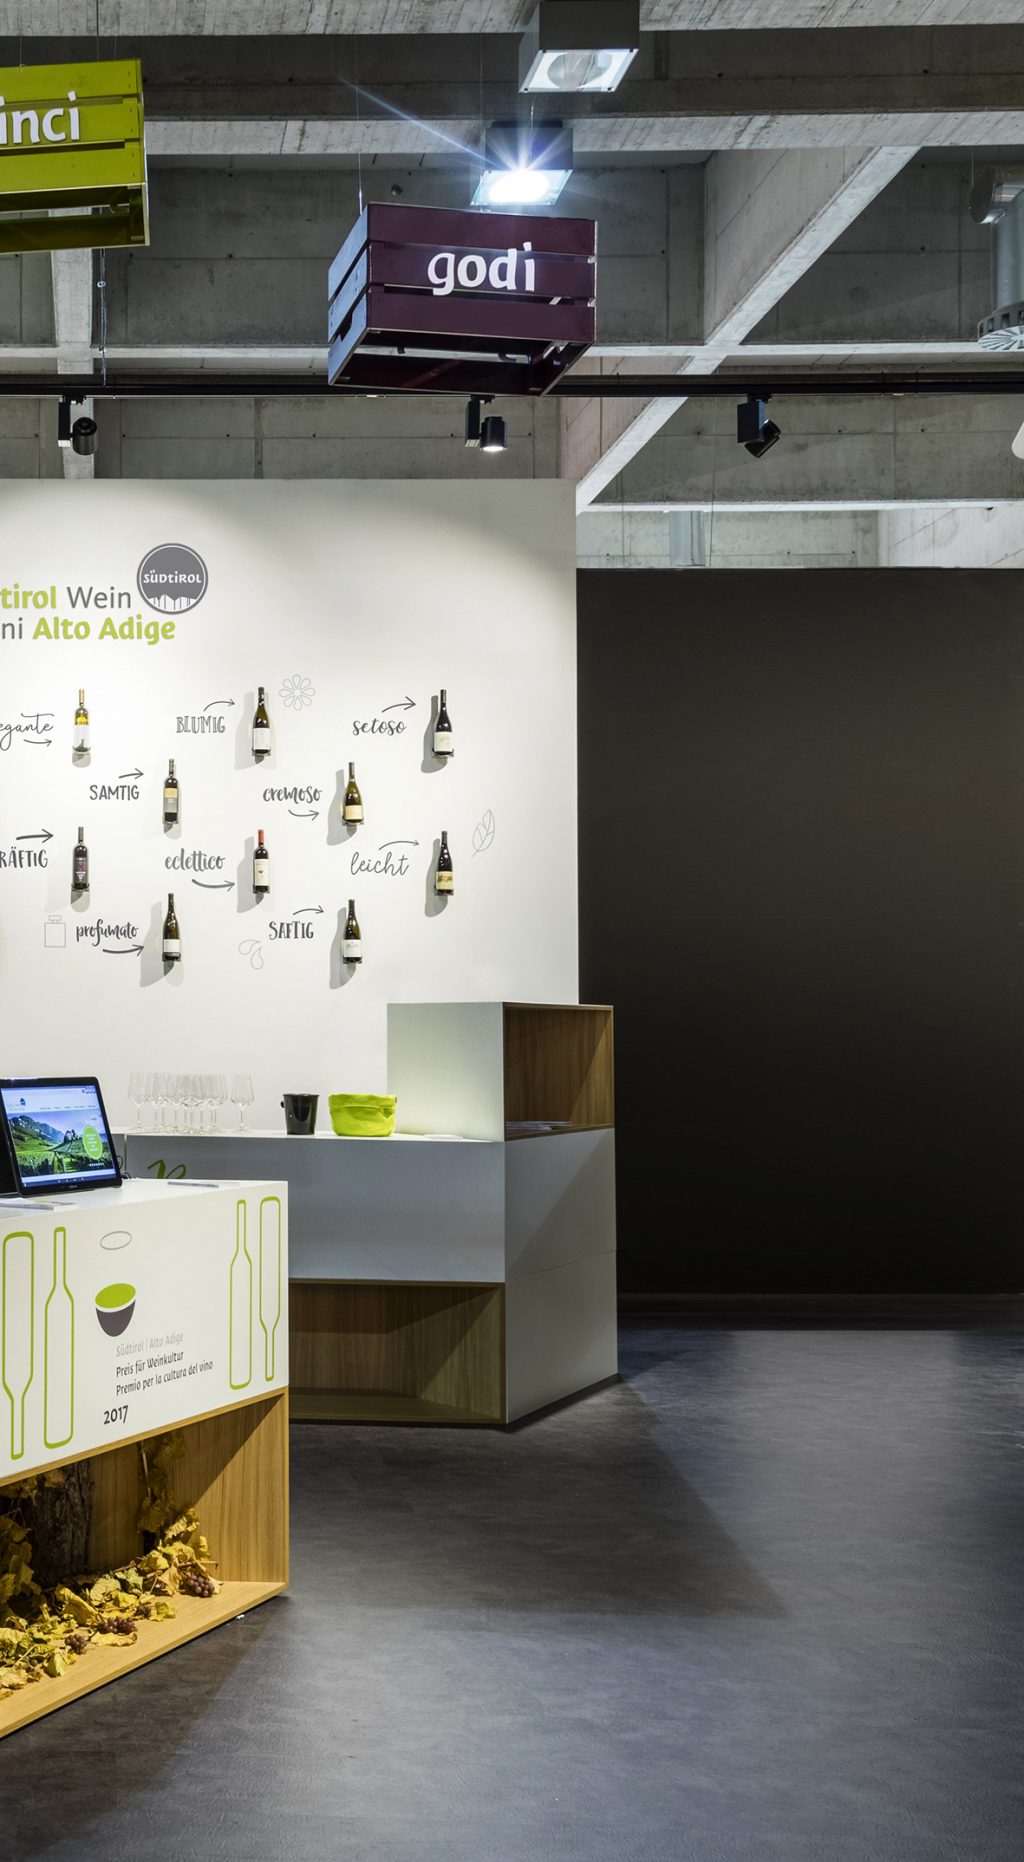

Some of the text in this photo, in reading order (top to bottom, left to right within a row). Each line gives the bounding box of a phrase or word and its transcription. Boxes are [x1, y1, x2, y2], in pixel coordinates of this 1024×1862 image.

[427, 241, 535, 296] godi
[67, 586, 131, 609] Wein
[32, 616, 90, 640] Alto
[98, 614, 176, 645] Adige
[176, 716, 225, 734] BLUMIG
[352, 718, 407, 736] setoso
[89, 785, 139, 800] SAMTIG
[263, 786, 322, 804] cremoso
[164, 848, 225, 872] eclettico
[350, 852, 410, 876] leicht
[76, 919, 138, 947] profumato
[269, 921, 313, 940] SAFTIG
[116, 1341, 144, 1357] Südtirol
[149, 1336, 164, 1348] Alto
[165, 1331, 184, 1346] Adige
[116, 1351, 184, 1378] Preis für Weinkultur
[116, 1359, 213, 1396] Premio per la cultura del vino
[104, 1405, 129, 1425] 2017
